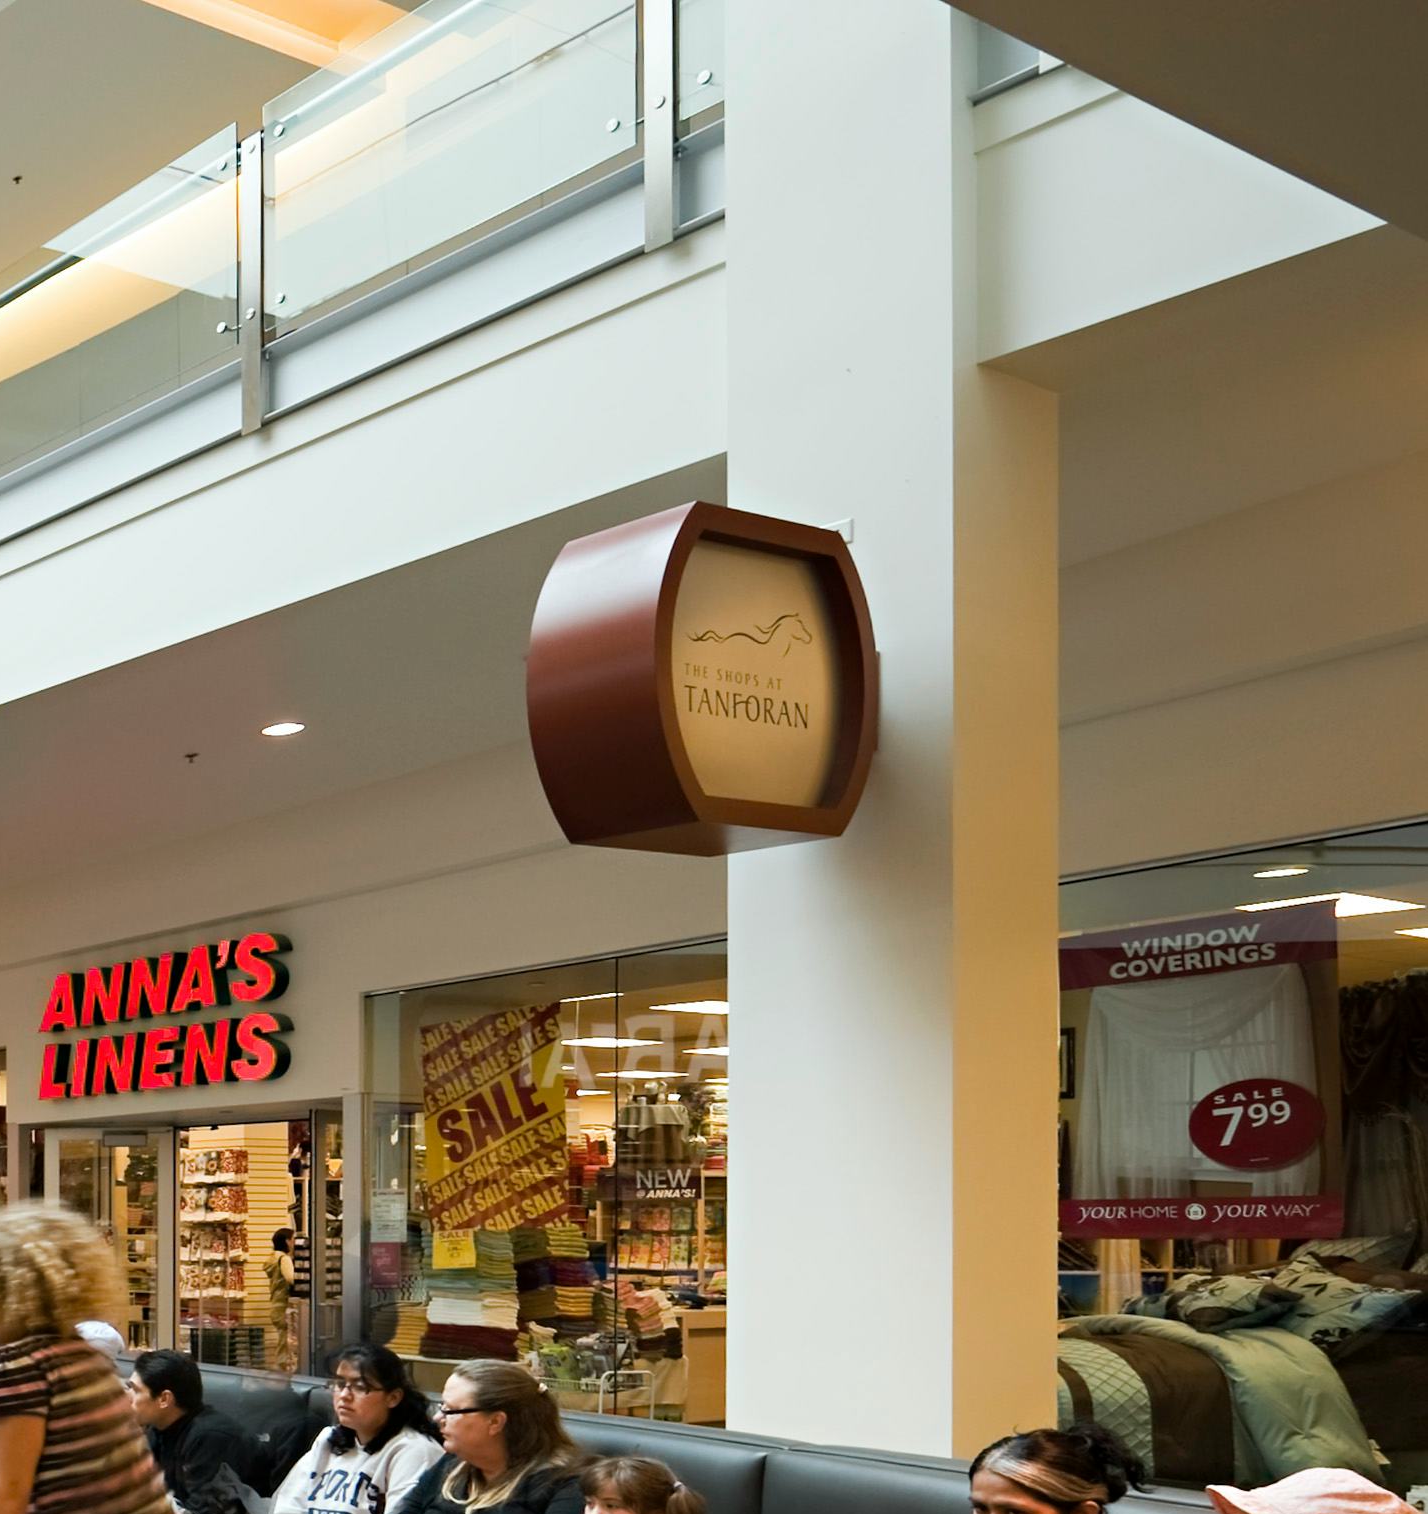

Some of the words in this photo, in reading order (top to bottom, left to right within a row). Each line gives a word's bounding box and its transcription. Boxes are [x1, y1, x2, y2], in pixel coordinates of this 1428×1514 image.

[684, 662, 709, 680] THE
[716, 667, 759, 688] SHOPS
[765, 676, 783, 691] AT
[683, 684, 809, 730] TANFORAN
[1120, 922, 1262, 959] WINDOW
[1107, 942, 1277, 981] COVERINGS
[38, 932, 283, 1033] ANNA'S
[38, 1011, 285, 1101] LINENS
[423, 1022, 453, 1051] ALE
[426, 1046, 463, 1082] SALE
[459, 1023, 499, 1060] SALE
[434, 1072, 474, 1108] SALE
[470, 1049, 510, 1085] SALE
[1212, 1086, 1284, 1105] SALE
[436, 1069, 549, 1163] SALE
[431, 1173, 467, 1205] SALE
[462, 1150, 502, 1186] SALE
[499, 1127, 540, 1165] SALE
[636, 1168, 692, 1190] NEW
[440, 1198, 476, 1231] SALE
[473, 1177, 512, 1213] SALE
[509, 1157, 551, 1192] SALE
[521, 1184, 565, 1220] SALE
[645, 1188, 696, 1199] ANNA'S!
[1130, 1205, 1178, 1219] HOME
